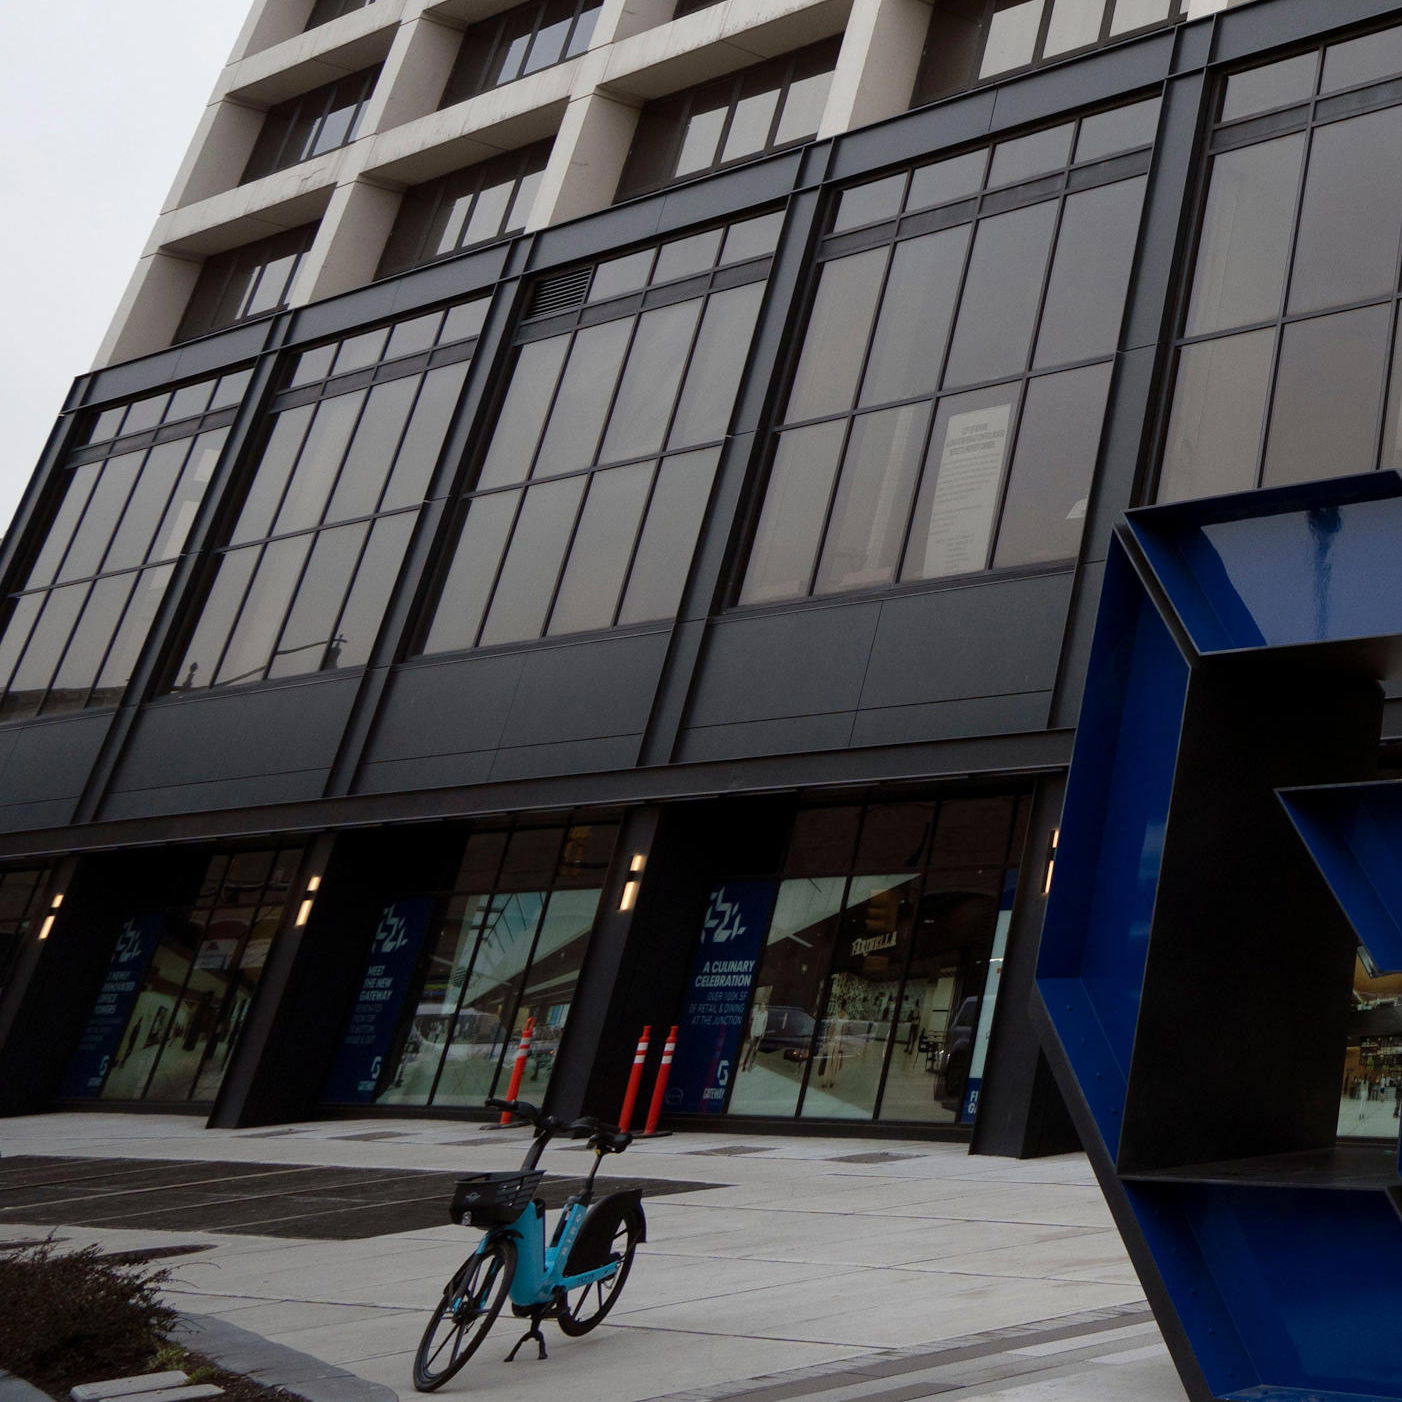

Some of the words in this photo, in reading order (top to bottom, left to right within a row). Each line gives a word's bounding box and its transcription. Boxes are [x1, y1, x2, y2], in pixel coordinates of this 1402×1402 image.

[703, 961, 710, 973] A
[711, 960, 755, 973] CULINARY
[695, 974, 752, 987] CELEBRATION
